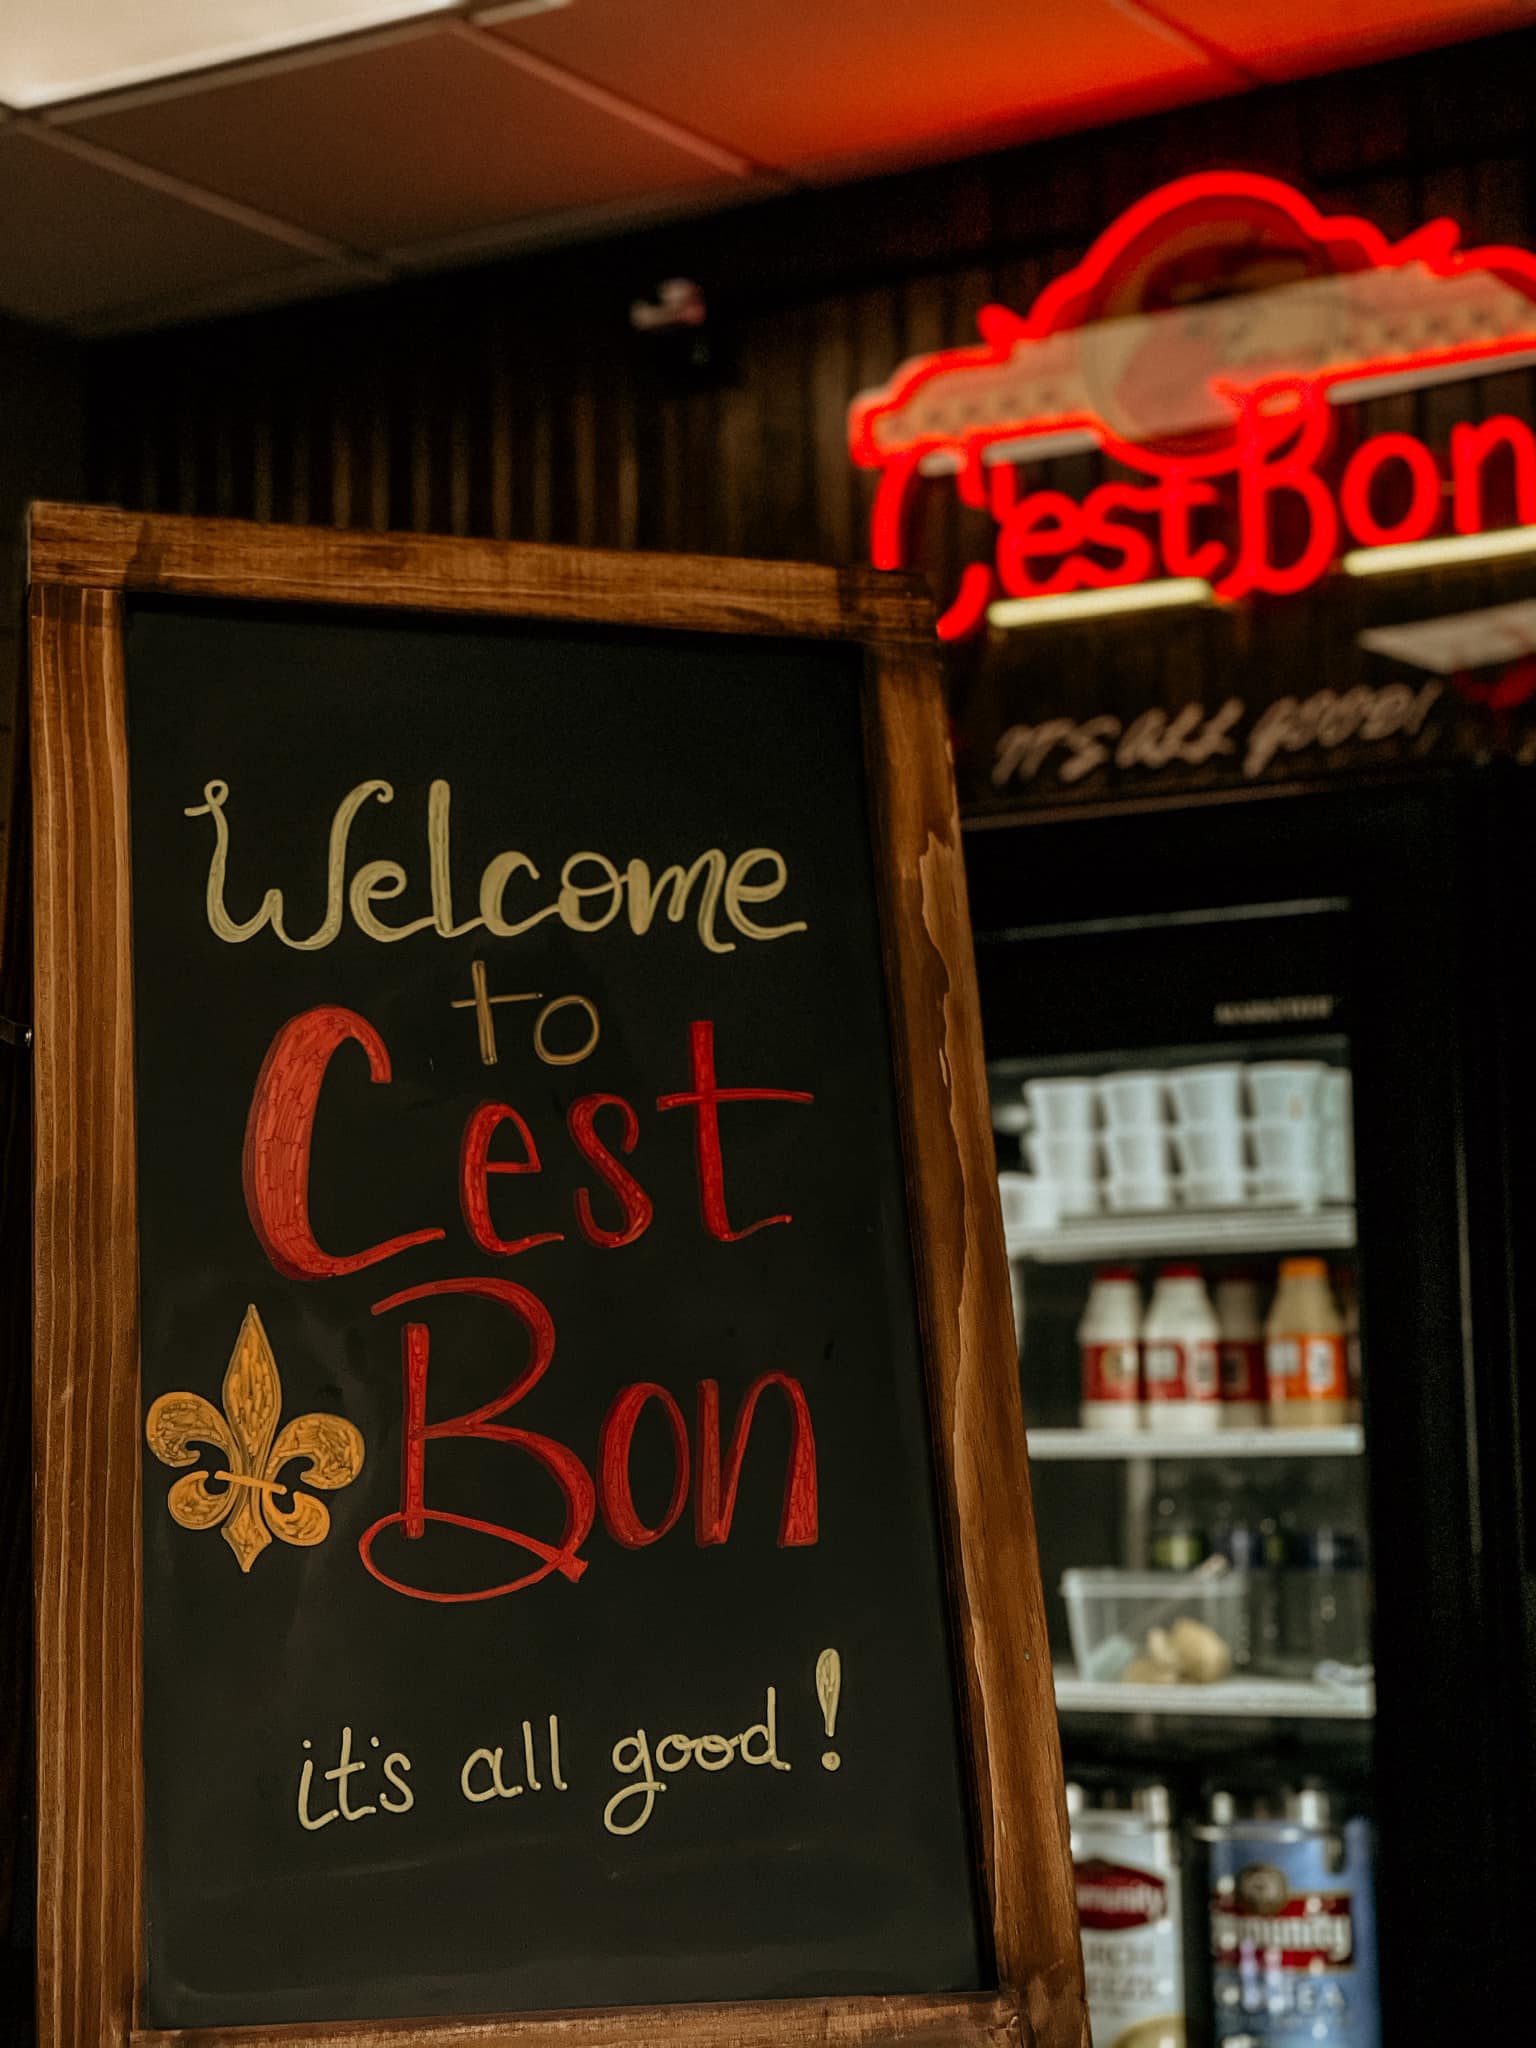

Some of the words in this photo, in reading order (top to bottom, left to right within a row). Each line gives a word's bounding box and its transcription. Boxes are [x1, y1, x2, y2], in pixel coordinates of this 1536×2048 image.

[1208, 380, 1536, 602] Bon
[183, 779, 809, 955] Welcome
[451, 959, 602, 1067] to
[242, 1005, 815, 1283] Cest
[357, 1276, 821, 1605] Bon
[296, 1726, 416, 1833] it's
[460, 1714, 570, 1805] all
